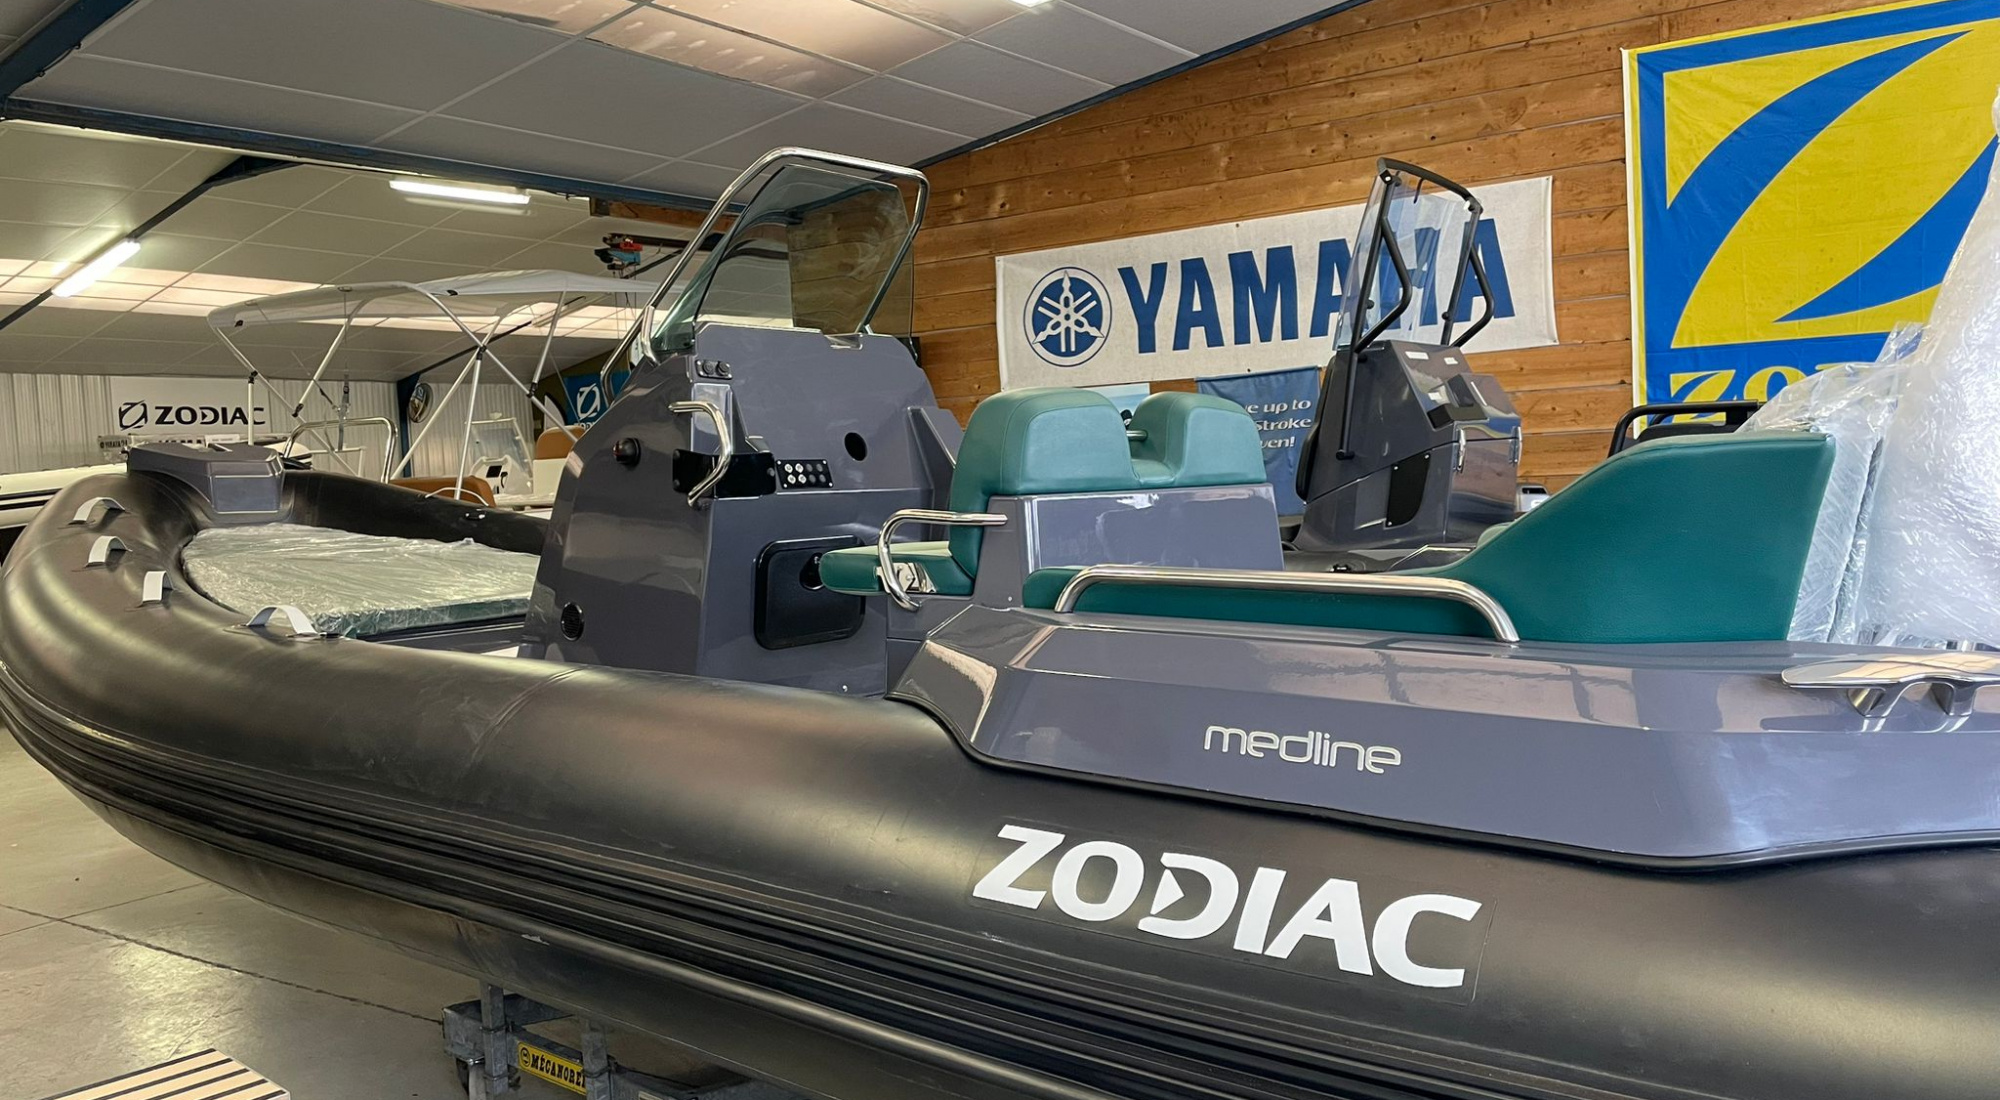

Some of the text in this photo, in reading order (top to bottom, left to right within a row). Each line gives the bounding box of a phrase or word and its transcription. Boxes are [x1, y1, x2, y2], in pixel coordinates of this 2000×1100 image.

[1117, 217, 1516, 355] YAMAHA
[154, 405, 266, 426] ZODIAC
[1263, 402, 1288, 414] up
[1292, 399, 1312, 410] to
[1203, 725, 1402, 774] medline
[972, 824, 1483, 988] ZODIAC
